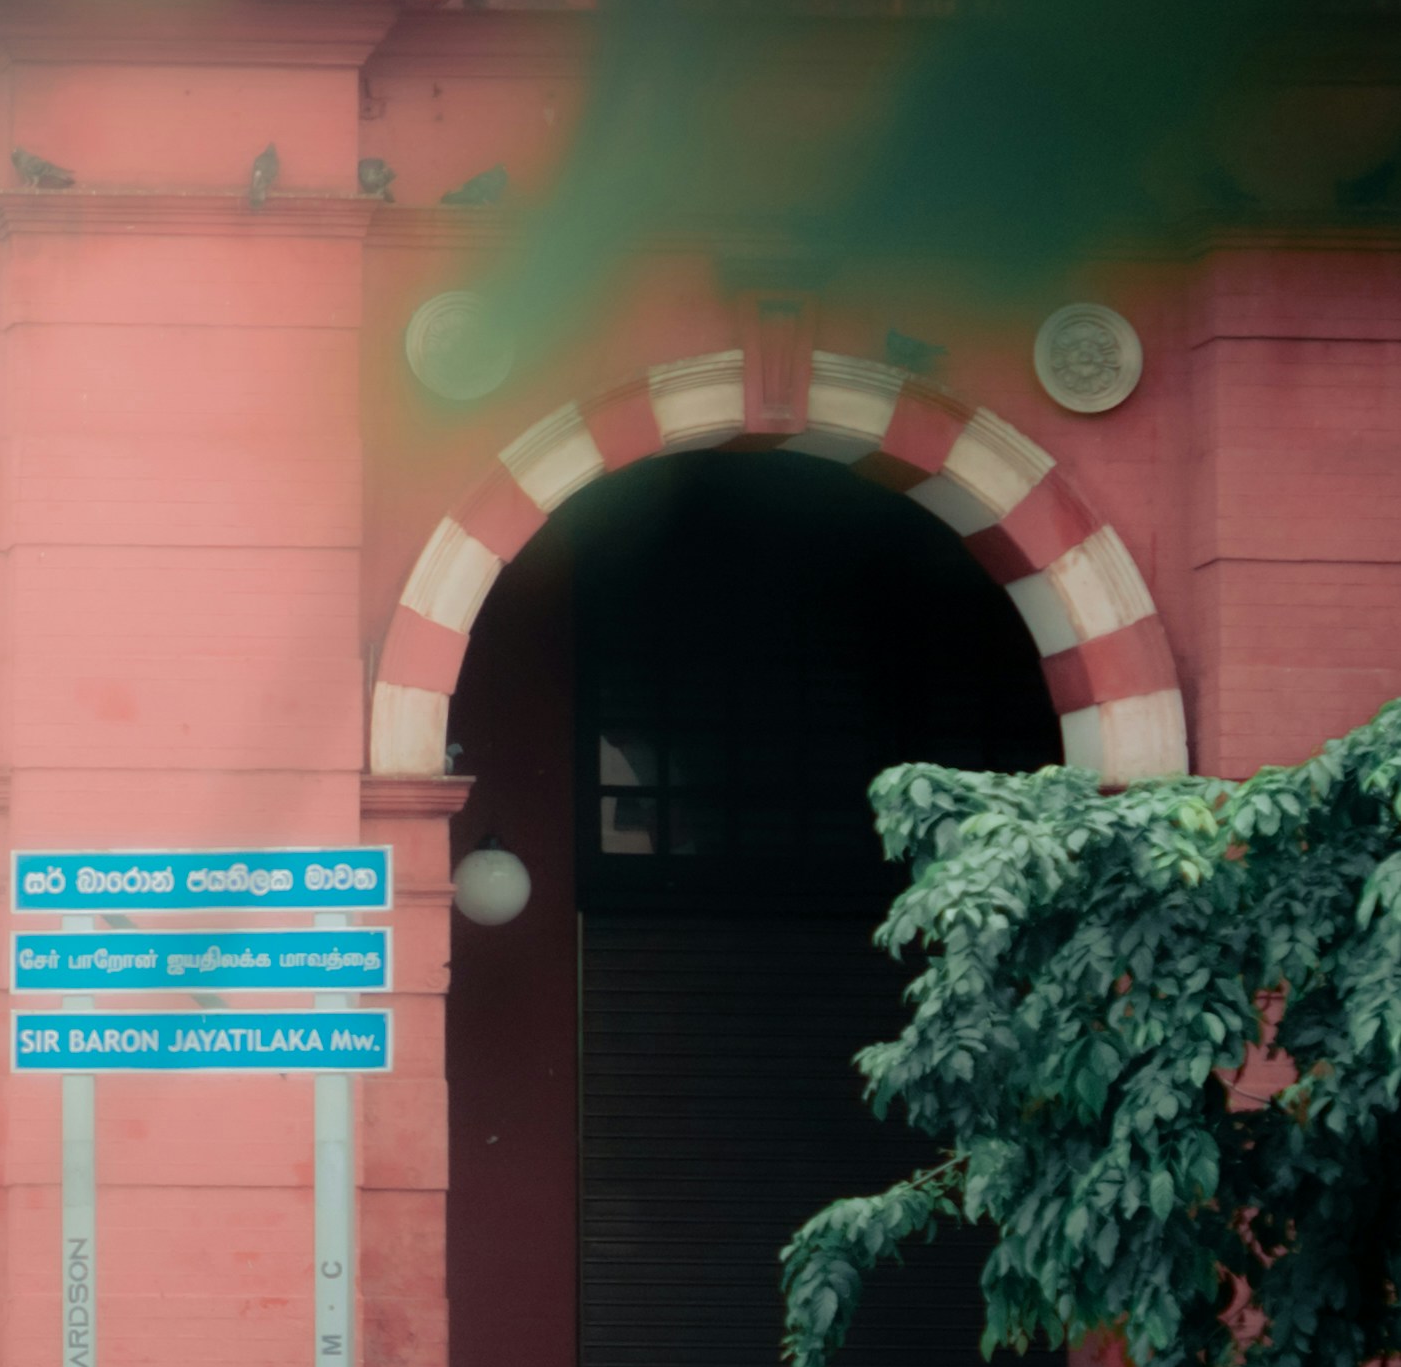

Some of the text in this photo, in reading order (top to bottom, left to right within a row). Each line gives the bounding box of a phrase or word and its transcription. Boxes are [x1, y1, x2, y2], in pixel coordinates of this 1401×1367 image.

[24, 866, 66, 894] සර්
[304, 863, 377, 891] මාවත
[19, 1027, 381, 1054] SIR BARON JAYATILAKA Mw.
